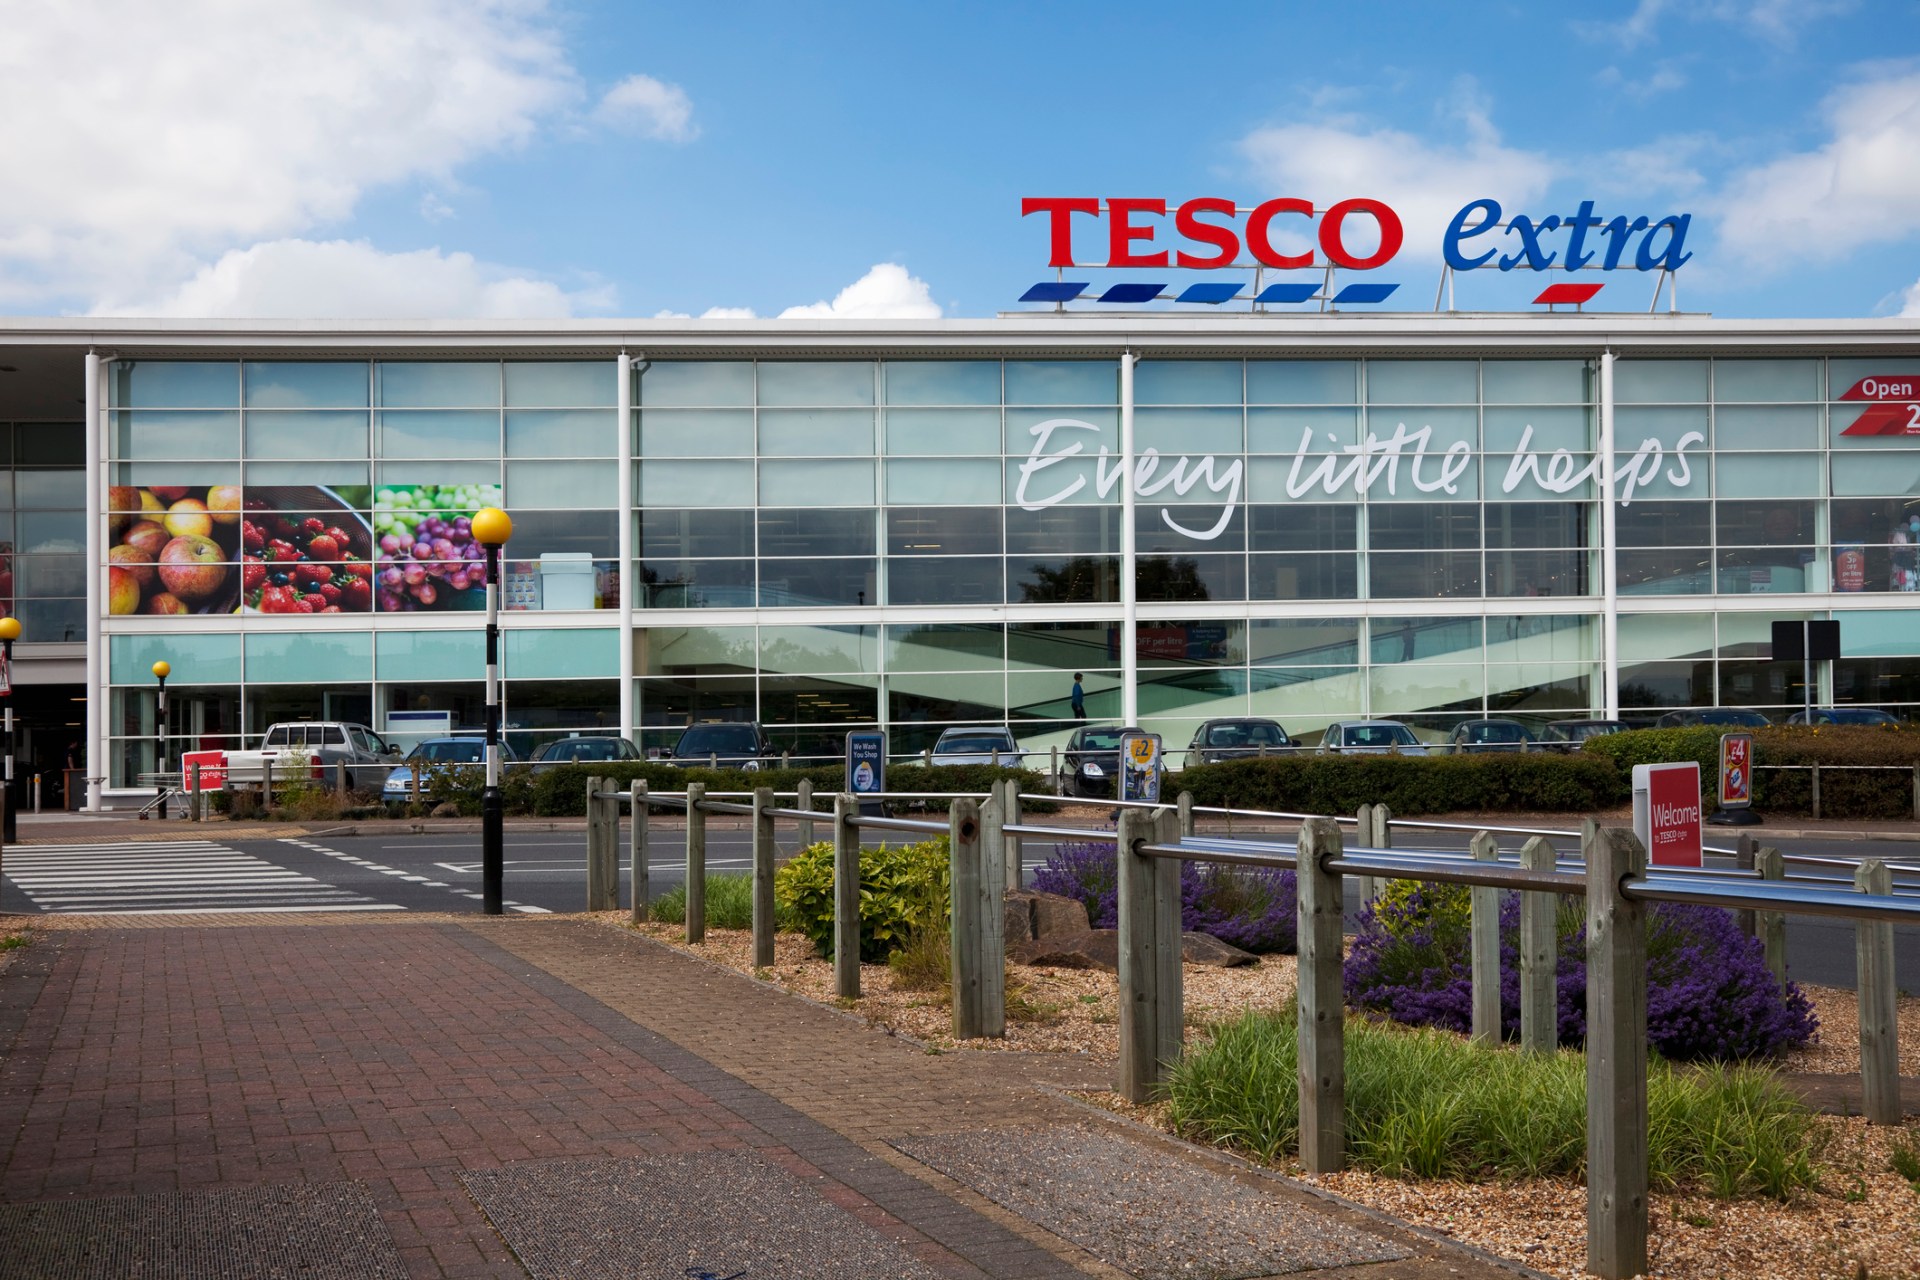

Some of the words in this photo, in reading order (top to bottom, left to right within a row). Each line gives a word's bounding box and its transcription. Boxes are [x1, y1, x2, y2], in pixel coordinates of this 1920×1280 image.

[1021, 197, 1404, 270] TESCO
[1442, 198, 1693, 272] extra
[1862, 379, 1912, 400] Open
[1016, 418, 1243, 541] Every
[1286, 422, 1471, 499] little
[1152, 638, 1166, 646] per
[1167, 636, 1183, 645] litre
[864, 751, 878, 759] Shop
[1135, 739, 1149, 756] £2
[1730, 739, 1745, 760] £4
[1652, 802, 1698, 828] Welcome
[1659, 830, 1677, 840] TESCO
